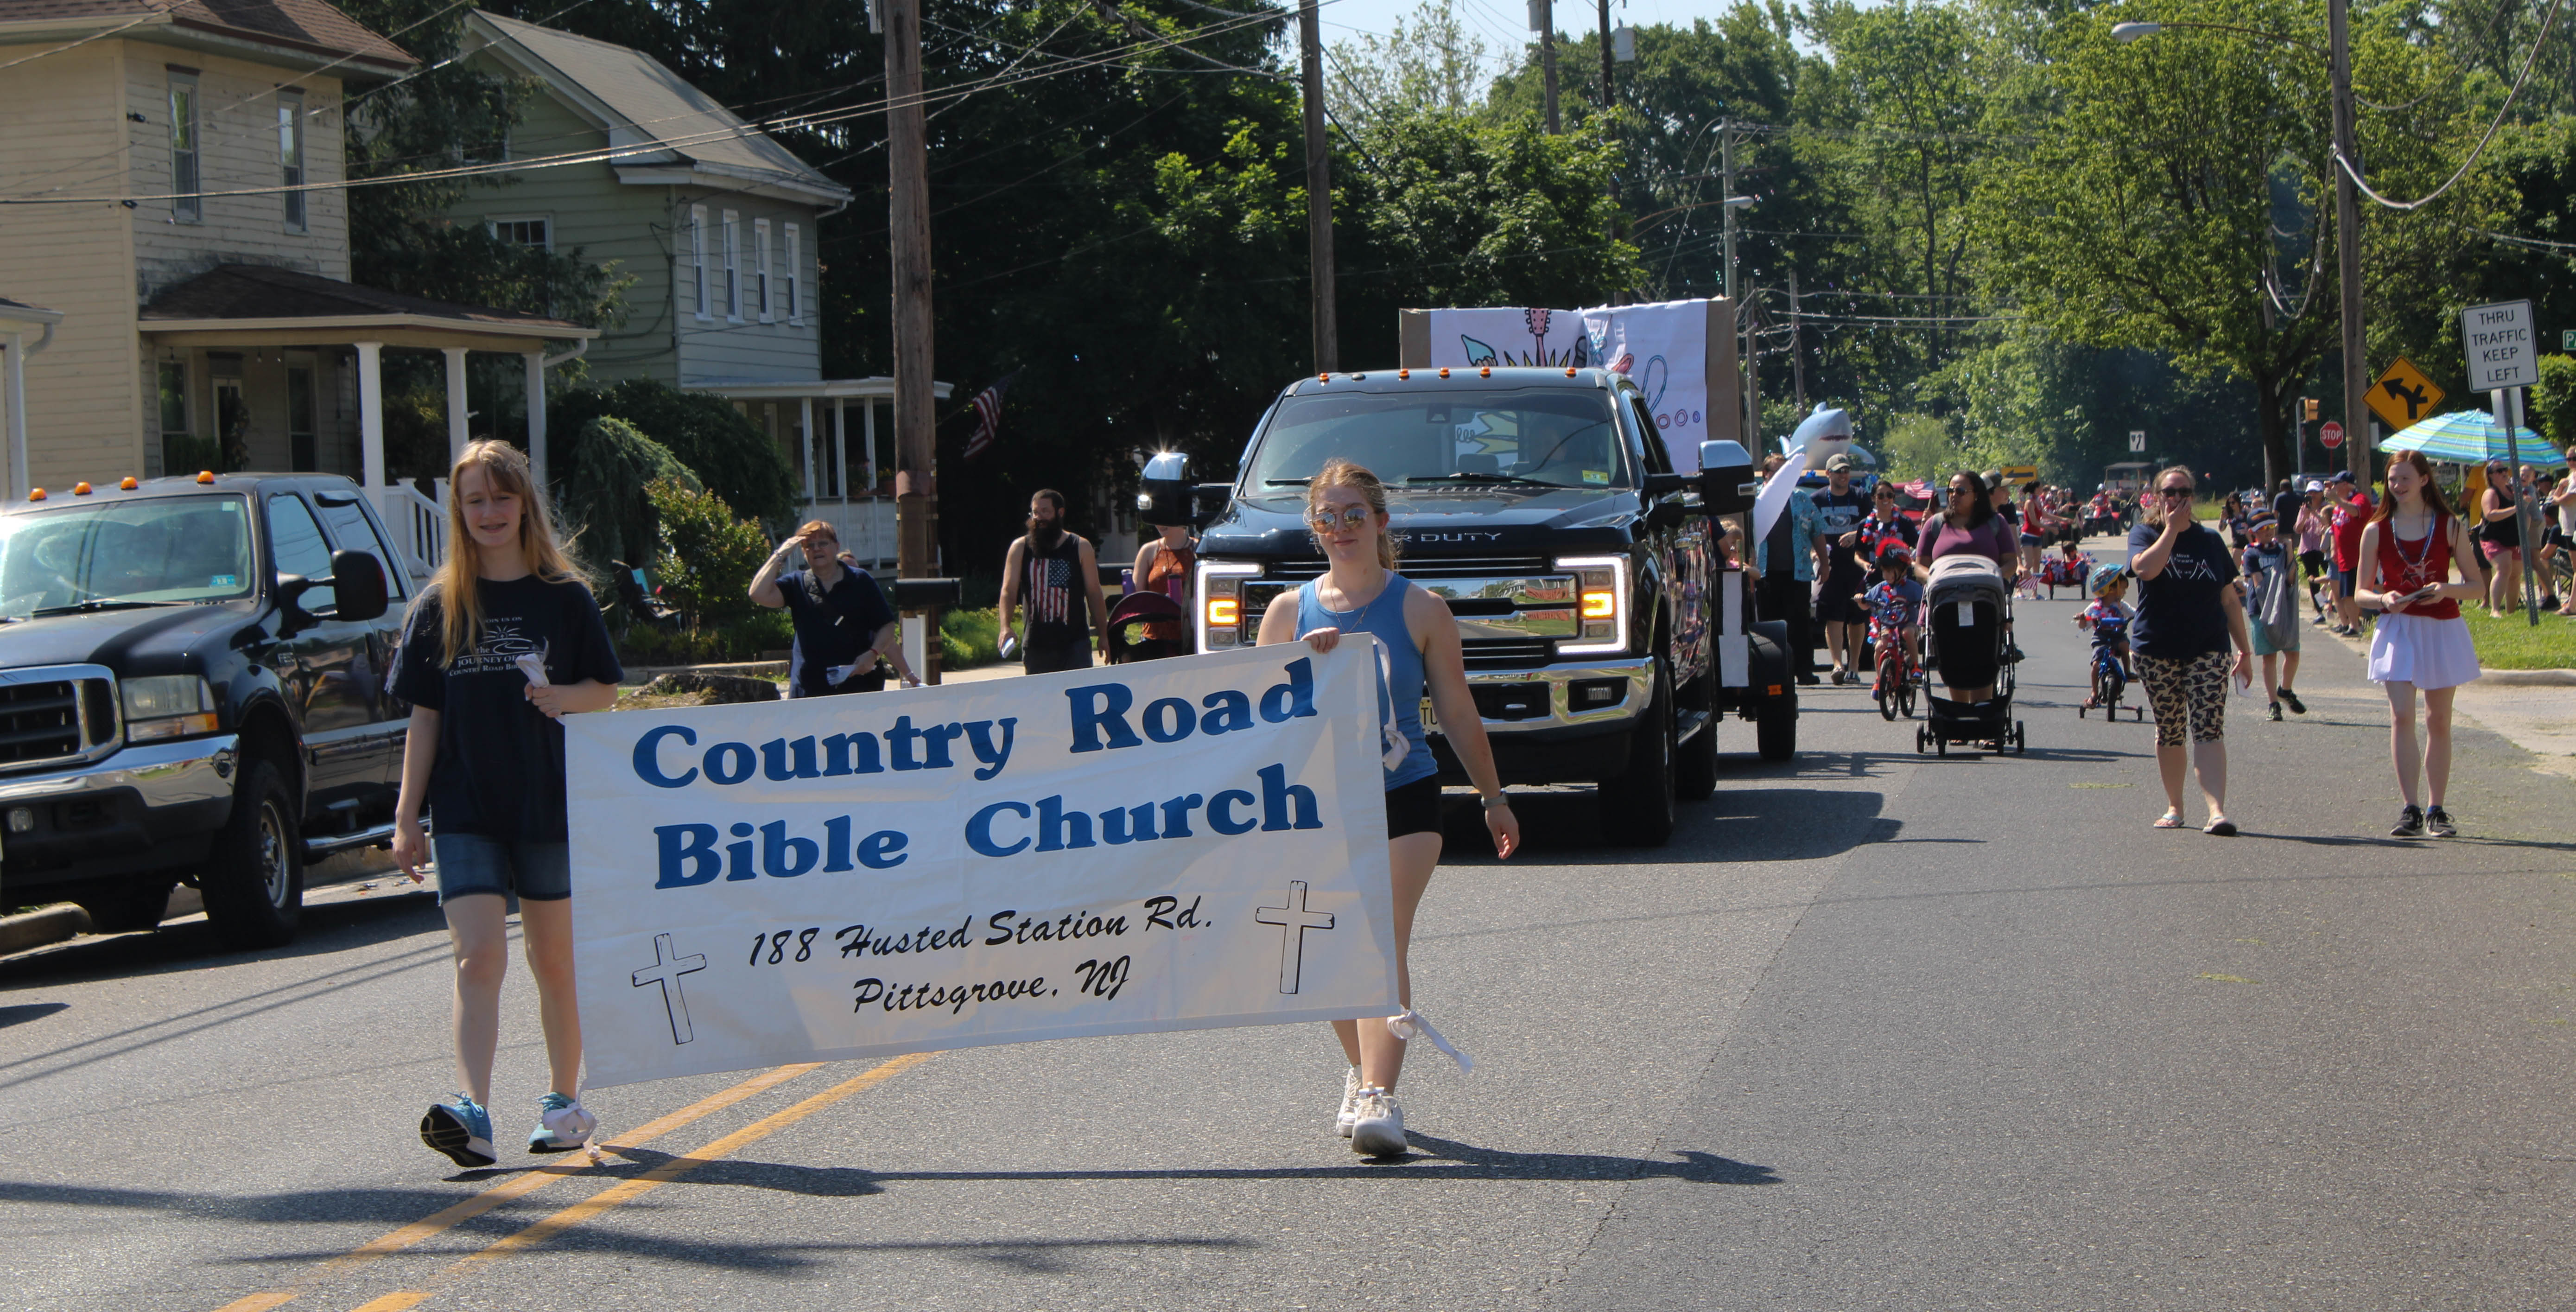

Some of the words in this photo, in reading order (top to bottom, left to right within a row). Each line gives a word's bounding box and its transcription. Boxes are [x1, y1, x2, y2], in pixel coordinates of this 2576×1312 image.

[2478, 309, 2514, 325] THRU
[2471, 328, 2527, 347] TRAFFIC
[2483, 347, 2519, 363] KEEP
[2487, 366, 2519, 382] LEFT
[2322, 430, 2341, 440] STOP
[1421, 532, 1502, 541] DUTY
[633, 716, 1018, 789] Country
[1065, 656, 1318, 753] Road
[654, 814, 909, 890] Bible
[965, 763, 1324, 857] Church
[749, 927, 819, 967] 188
[836, 915, 973, 959] Husted
[985, 910, 1130, 946] Station
[1144, 895, 1212, 931] Rd.
[1075, 955, 1130, 1001] NJ
